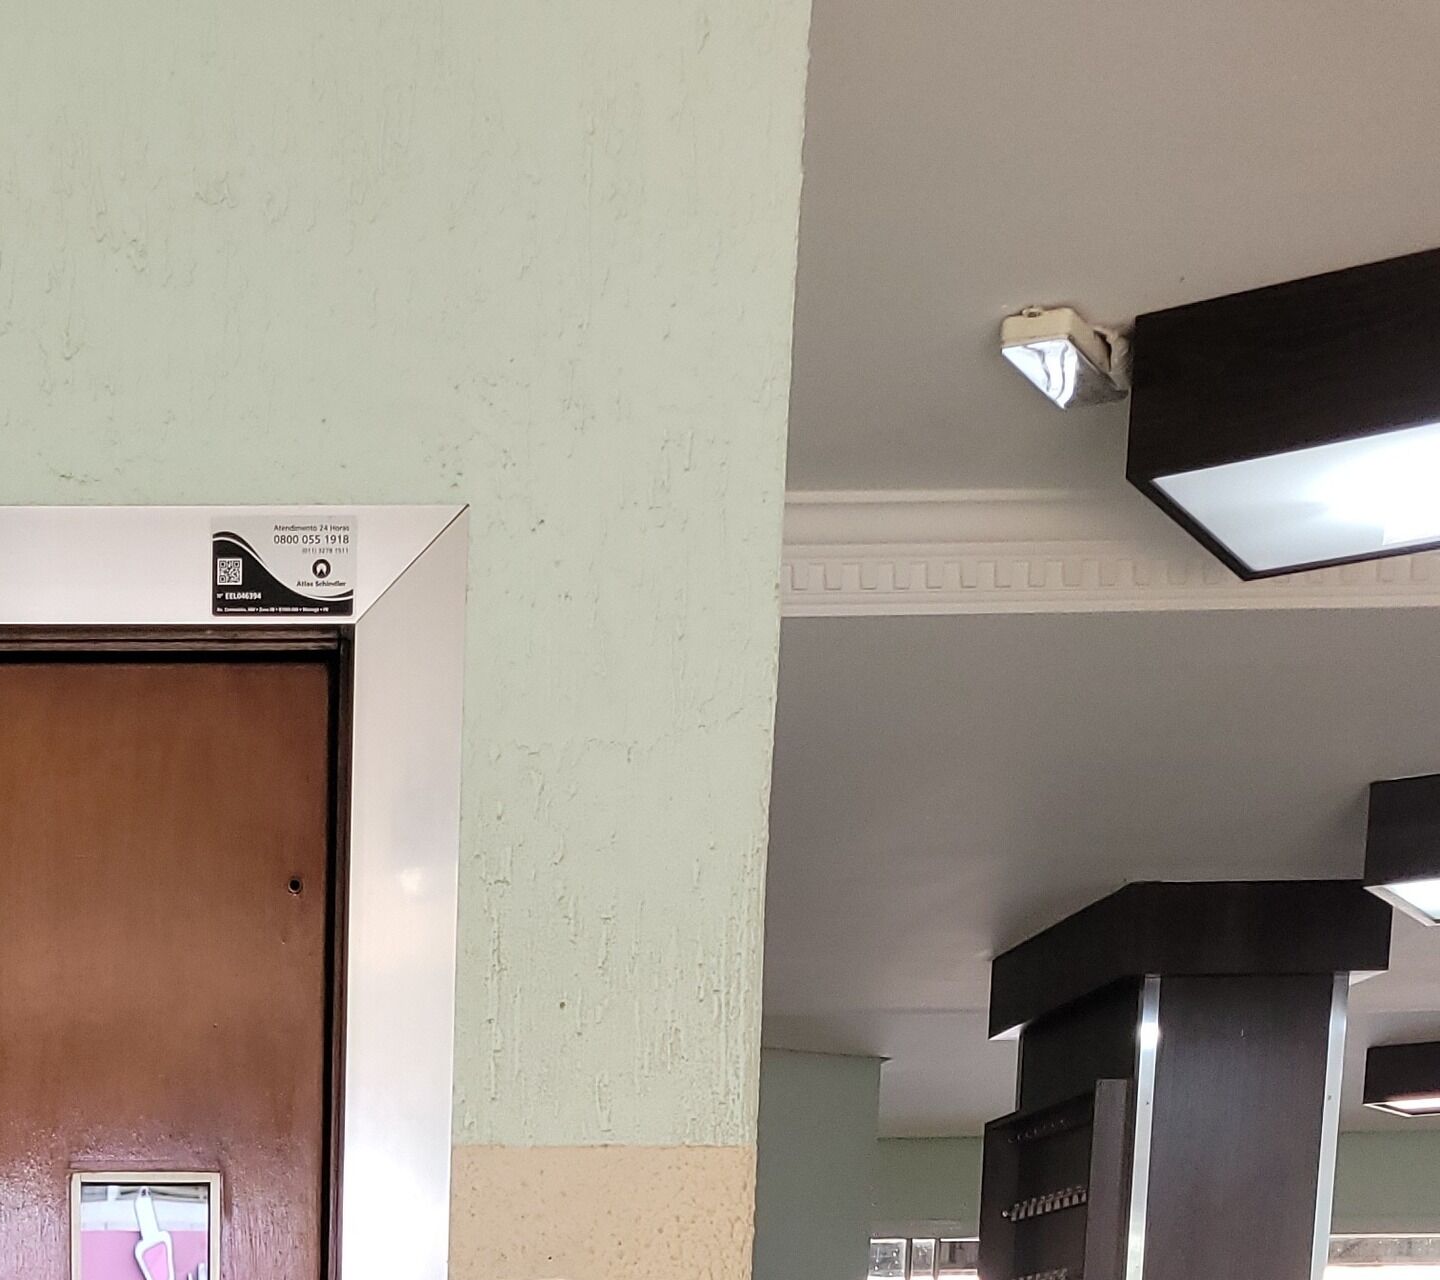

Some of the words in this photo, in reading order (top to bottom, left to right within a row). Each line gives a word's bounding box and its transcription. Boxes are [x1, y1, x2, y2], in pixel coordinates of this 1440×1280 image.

[273, 535, 299, 545] 0800
[302, 535, 321, 545] 055
[325, 535, 350, 545] 1918
